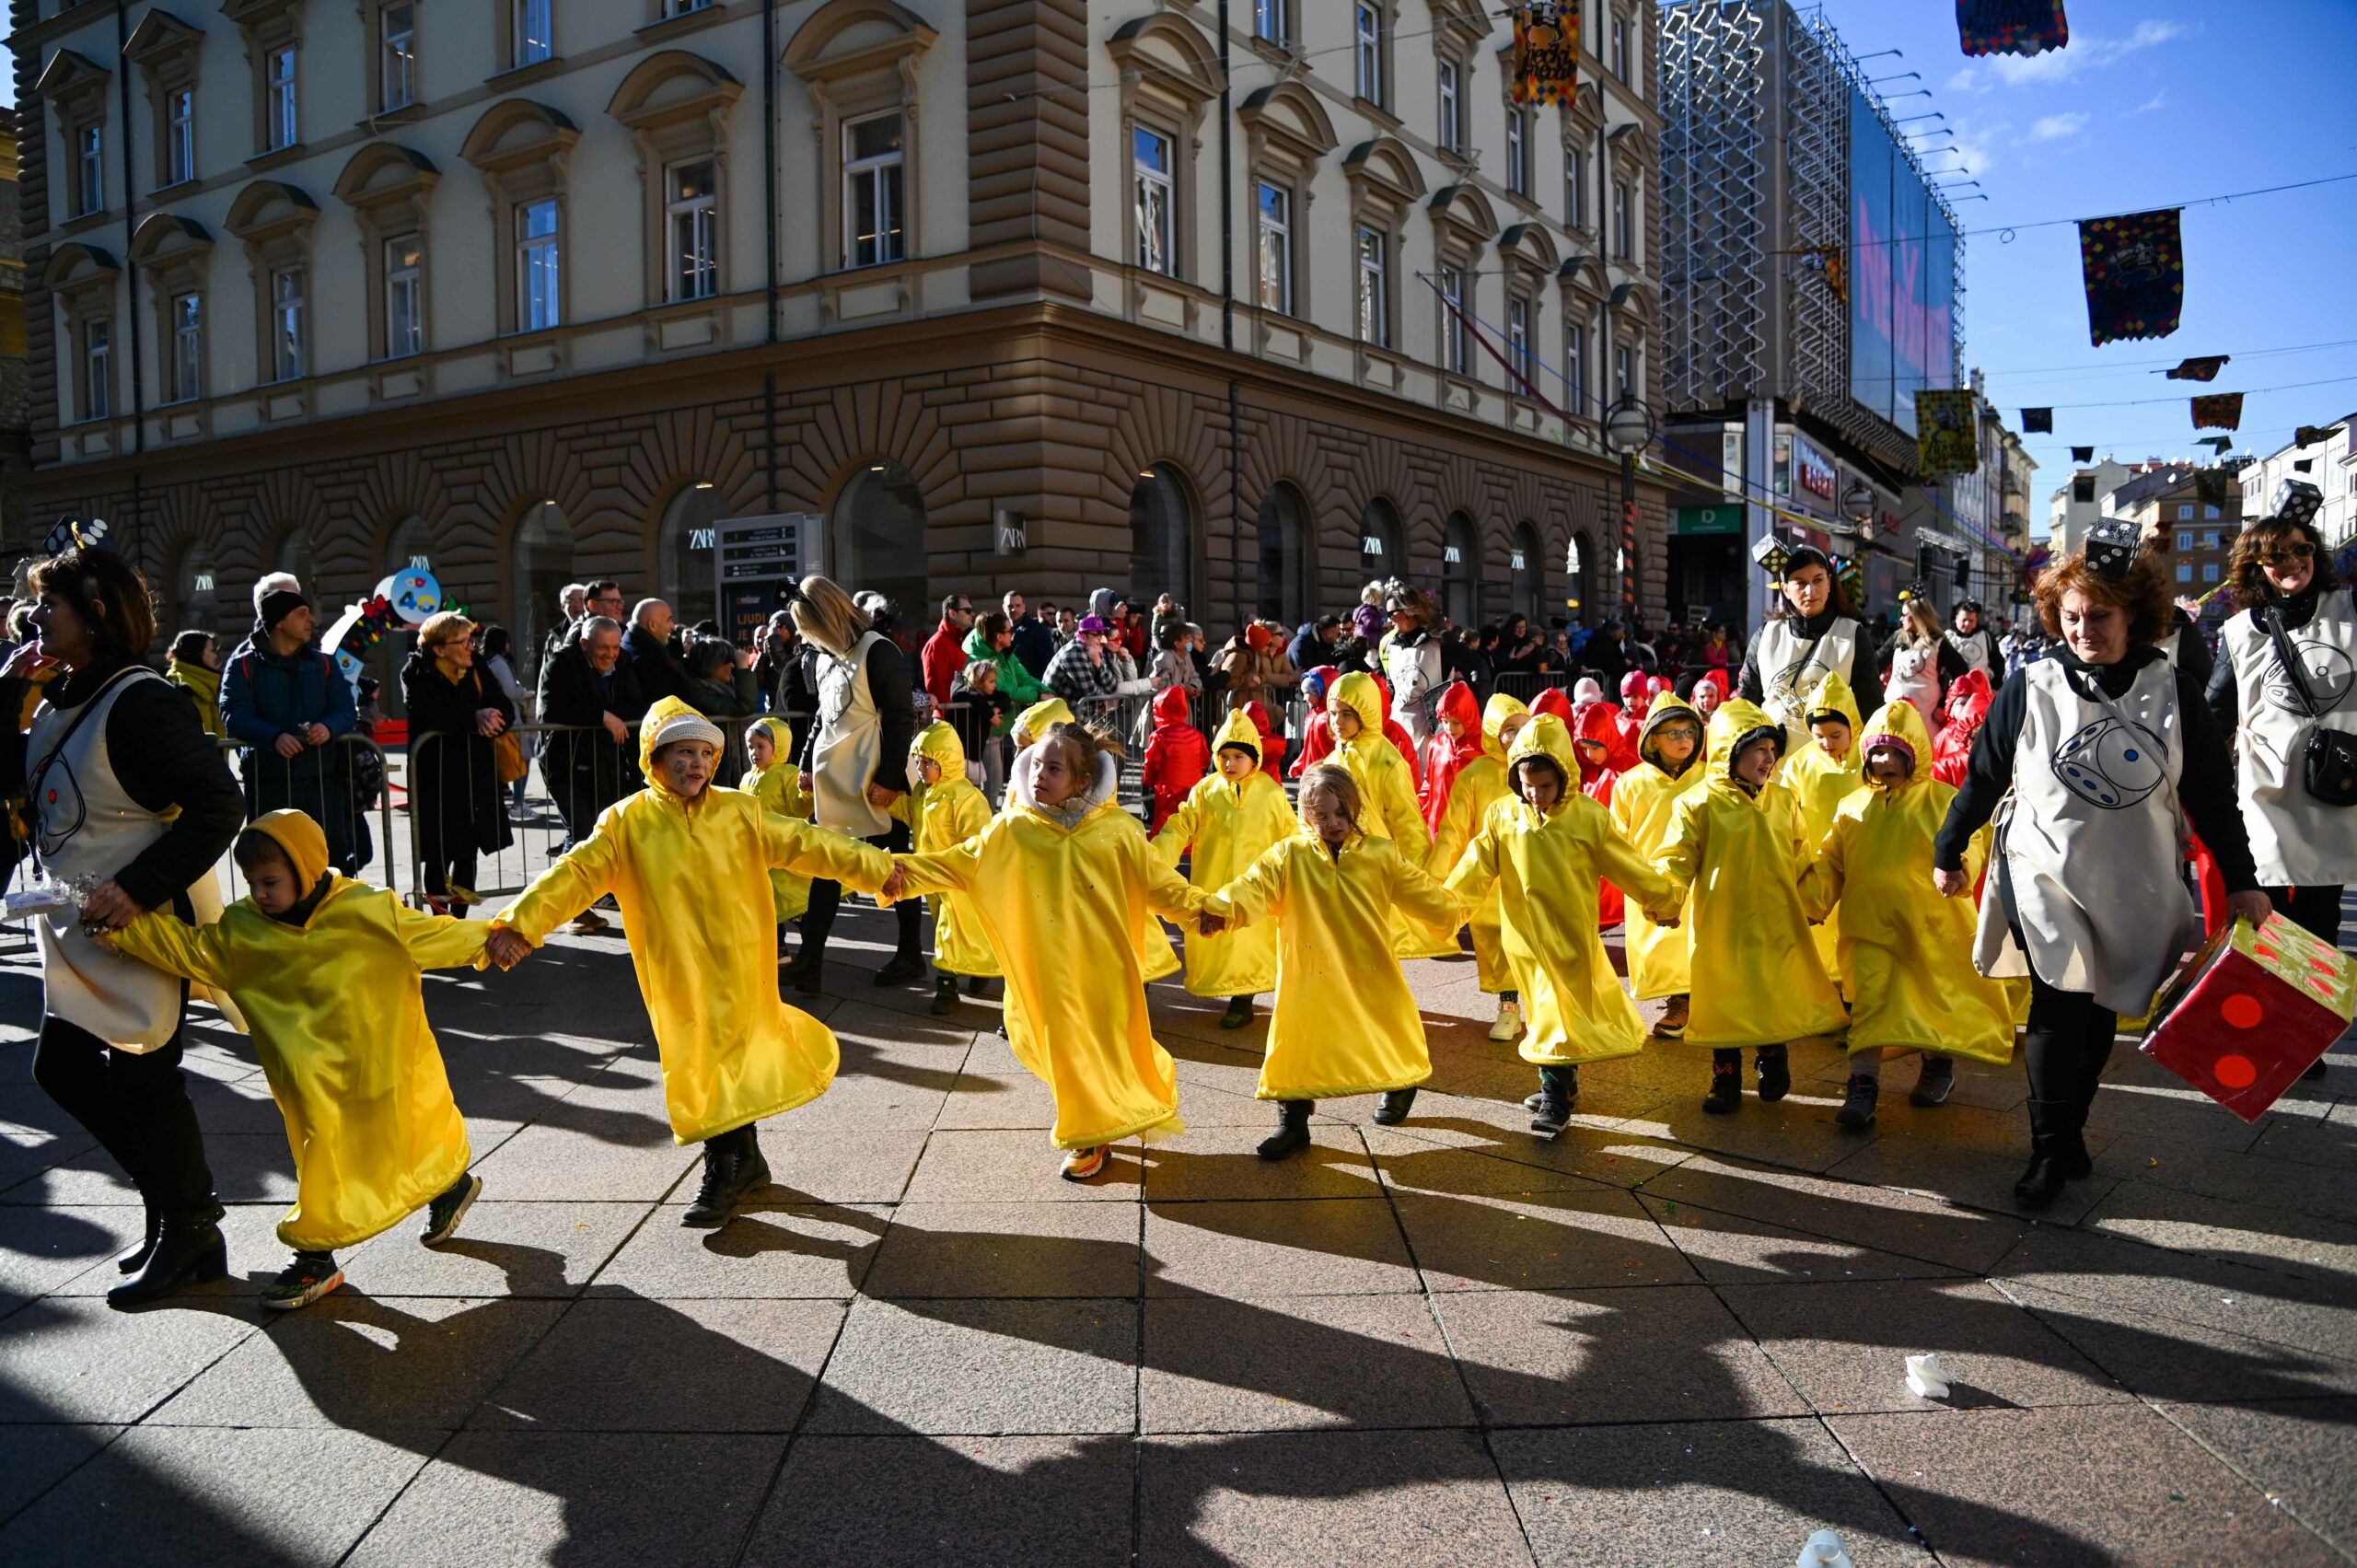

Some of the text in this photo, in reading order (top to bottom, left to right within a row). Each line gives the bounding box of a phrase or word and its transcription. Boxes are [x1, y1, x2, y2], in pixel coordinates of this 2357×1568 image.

[1701, 509, 1715, 523] D
[398, 591, 436, 613] 40
[737, 612, 766, 625] LJUDI
[737, 629, 749, 642] JE
